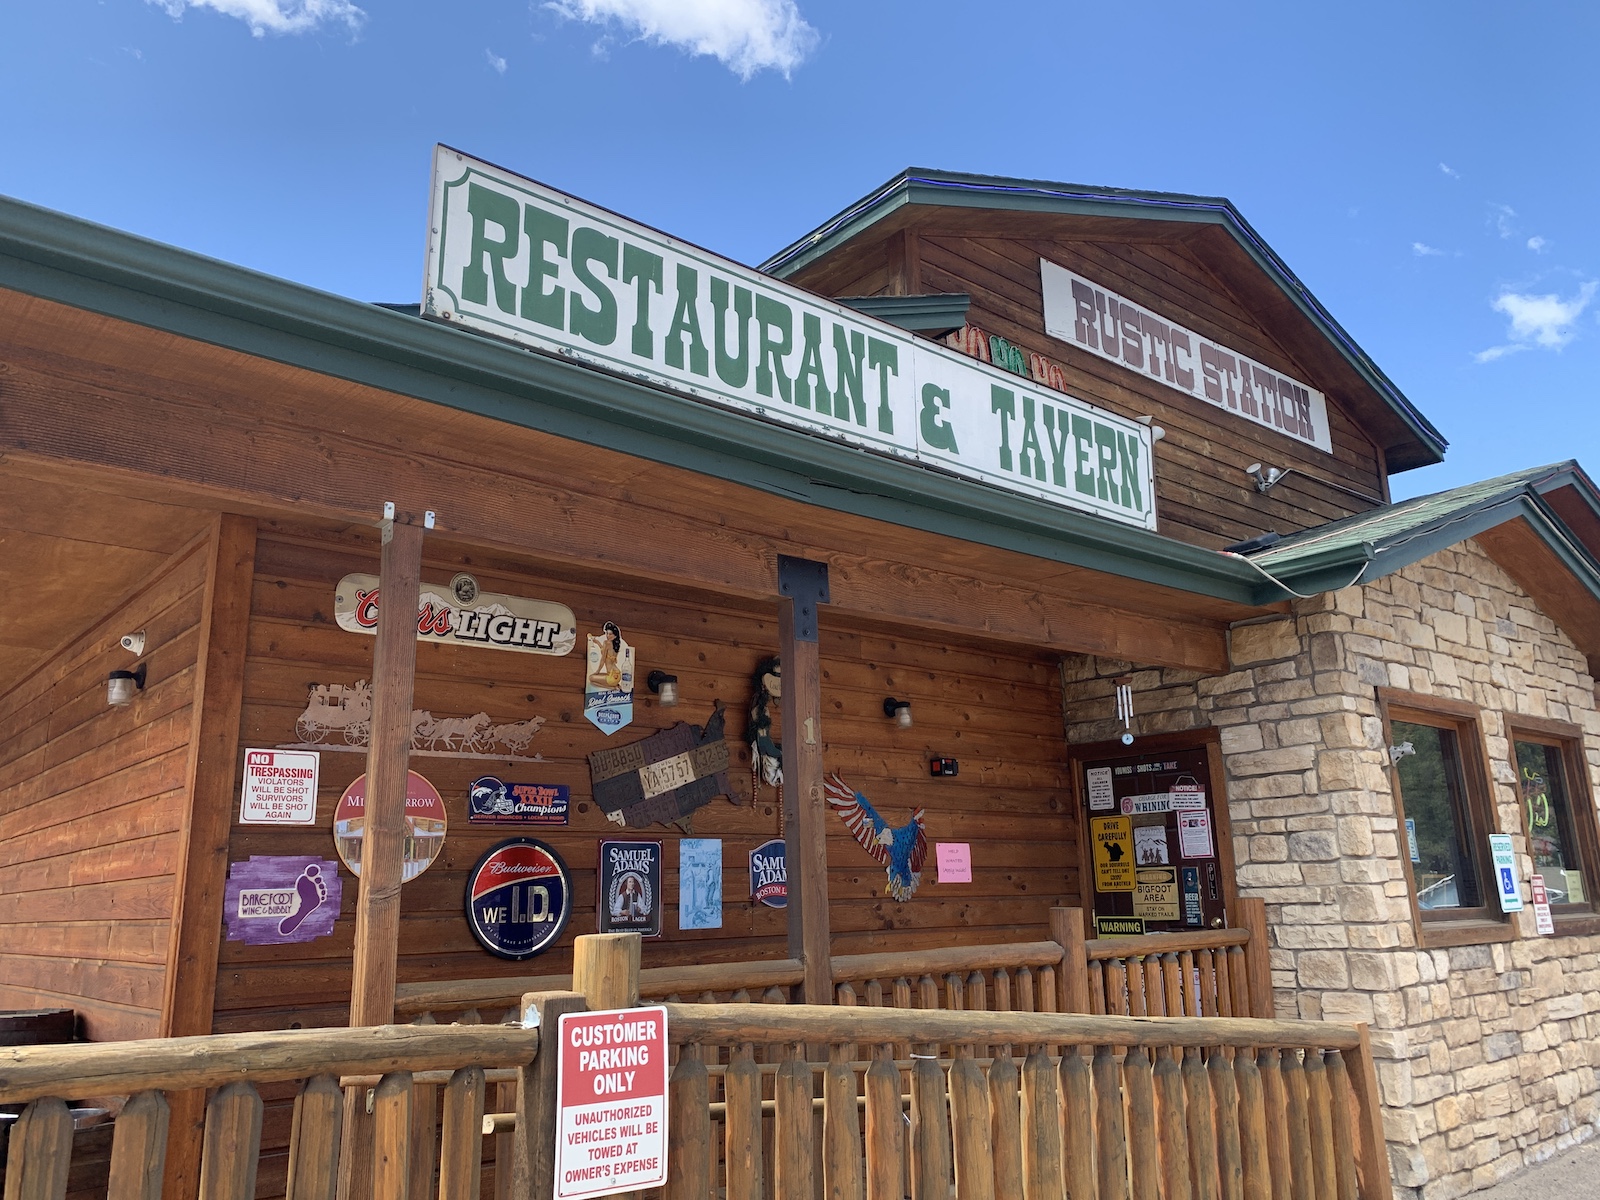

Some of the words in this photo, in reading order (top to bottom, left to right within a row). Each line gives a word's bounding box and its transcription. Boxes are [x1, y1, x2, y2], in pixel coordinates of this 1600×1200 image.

[462, 182, 898, 435] RESTAURANT
[920, 382, 958, 455] &
[990, 383, 1142, 513] TAVERN
[1071, 278, 1195, 392] RUSTIC
[1199, 342, 1316, 442] STATION
[454, 609, 561, 649] LIGHT
[804, 717, 816, 745] 1
[251, 754, 270, 764] NO
[250, 766, 313, 779] TRESPASSING
[1137, 764, 1152, 773] SHOTS
[1162, 761, 1177, 770] TAKE
[258, 778, 304, 786] VIOLATORS
[512, 785, 537, 796] SUPER
[538, 786, 559, 796] BOWL
[256, 794, 304, 802] SURVIVORS
[285, 803, 308, 811] SHOT
[515, 803, 566, 816] Champions
[1103, 822, 1119, 830] DRIVE
[1098, 831, 1127, 841] CAREFULLY
[609, 847, 655, 862] SAMUEL
[489, 861, 553, 875] Budweiser
[612, 860, 650, 876] ADAMS
[753, 854, 786, 873] SAMU
[757, 869, 787, 889] ADAM
[756, 886, 780, 900] BOSTON
[1137, 885, 1172, 893] BIGFOOT
[242, 893, 294, 906] BAREFOOT
[1144, 894, 1165, 902] AREA
[1185, 892, 1199, 901] BEER
[242, 907, 261, 915] WINE
[483, 907, 507, 924] WE
[511, 886, 554, 923] I.D.
[1100, 922, 1141, 932] WARNING
[571, 1020, 657, 1048] CUSTOMER
[579, 1045, 649, 1072] PARKING
[593, 1070, 636, 1095] ONLY
[575, 1104, 653, 1126] UNAUTHORIZED
[567, 1127, 617, 1145] VEHICLES
[620, 1124, 643, 1138] WILL
[645, 1121, 659, 1134] BE
[588, 1144, 623, 1161] TOWED
[625, 1142, 639, 1155] AT
[565, 1164, 611, 1183] OWNER'S
[613, 1157, 659, 1175] EXPENSE
